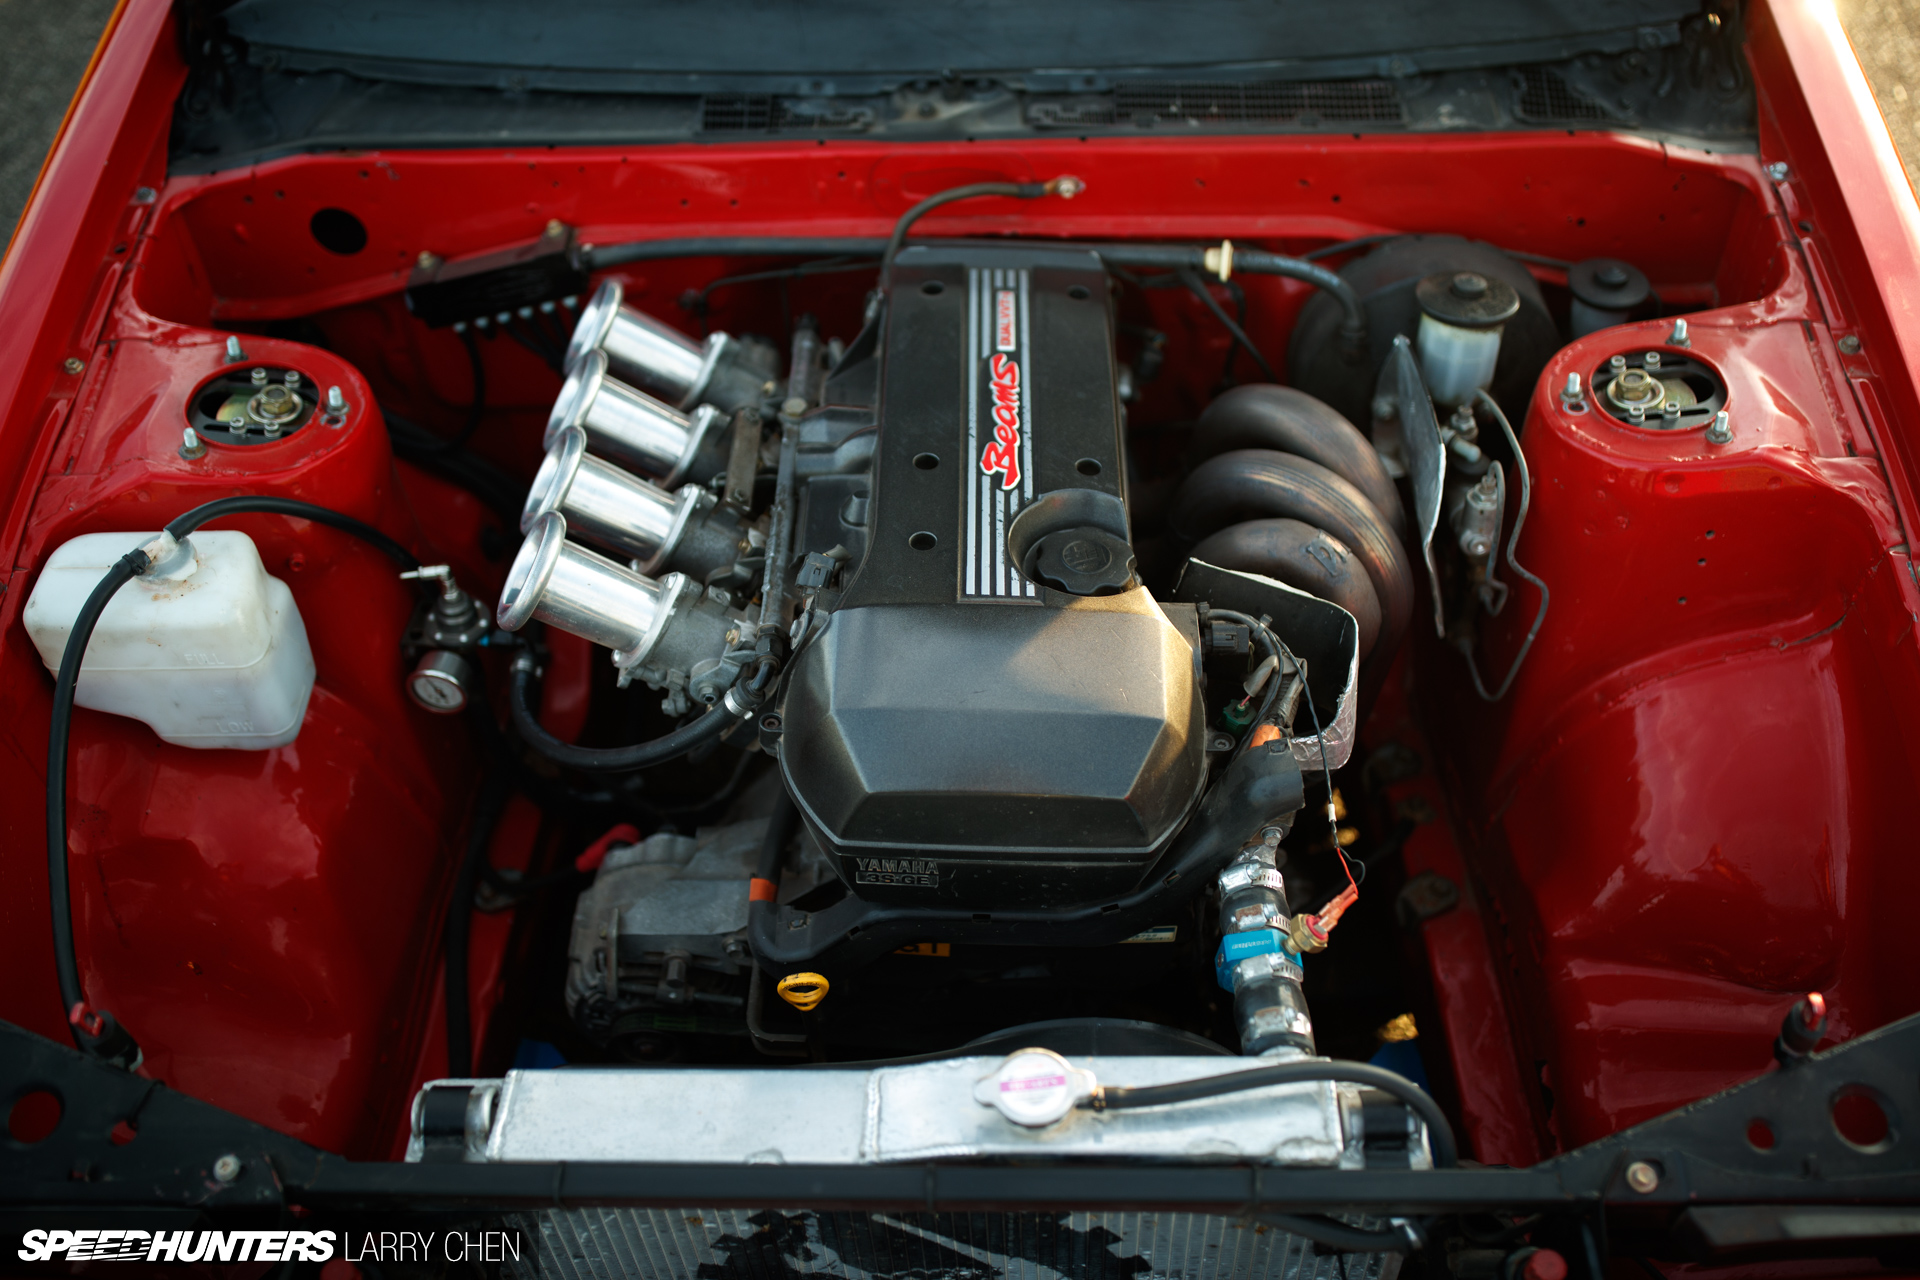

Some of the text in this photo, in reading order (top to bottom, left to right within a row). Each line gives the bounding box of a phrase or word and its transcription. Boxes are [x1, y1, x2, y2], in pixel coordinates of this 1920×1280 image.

[999, 322, 1011, 346] DUAL
[184, 653, 225, 665] FULL
[216, 721, 254, 733] LOW
[856, 857, 939, 874] YAMAHA
